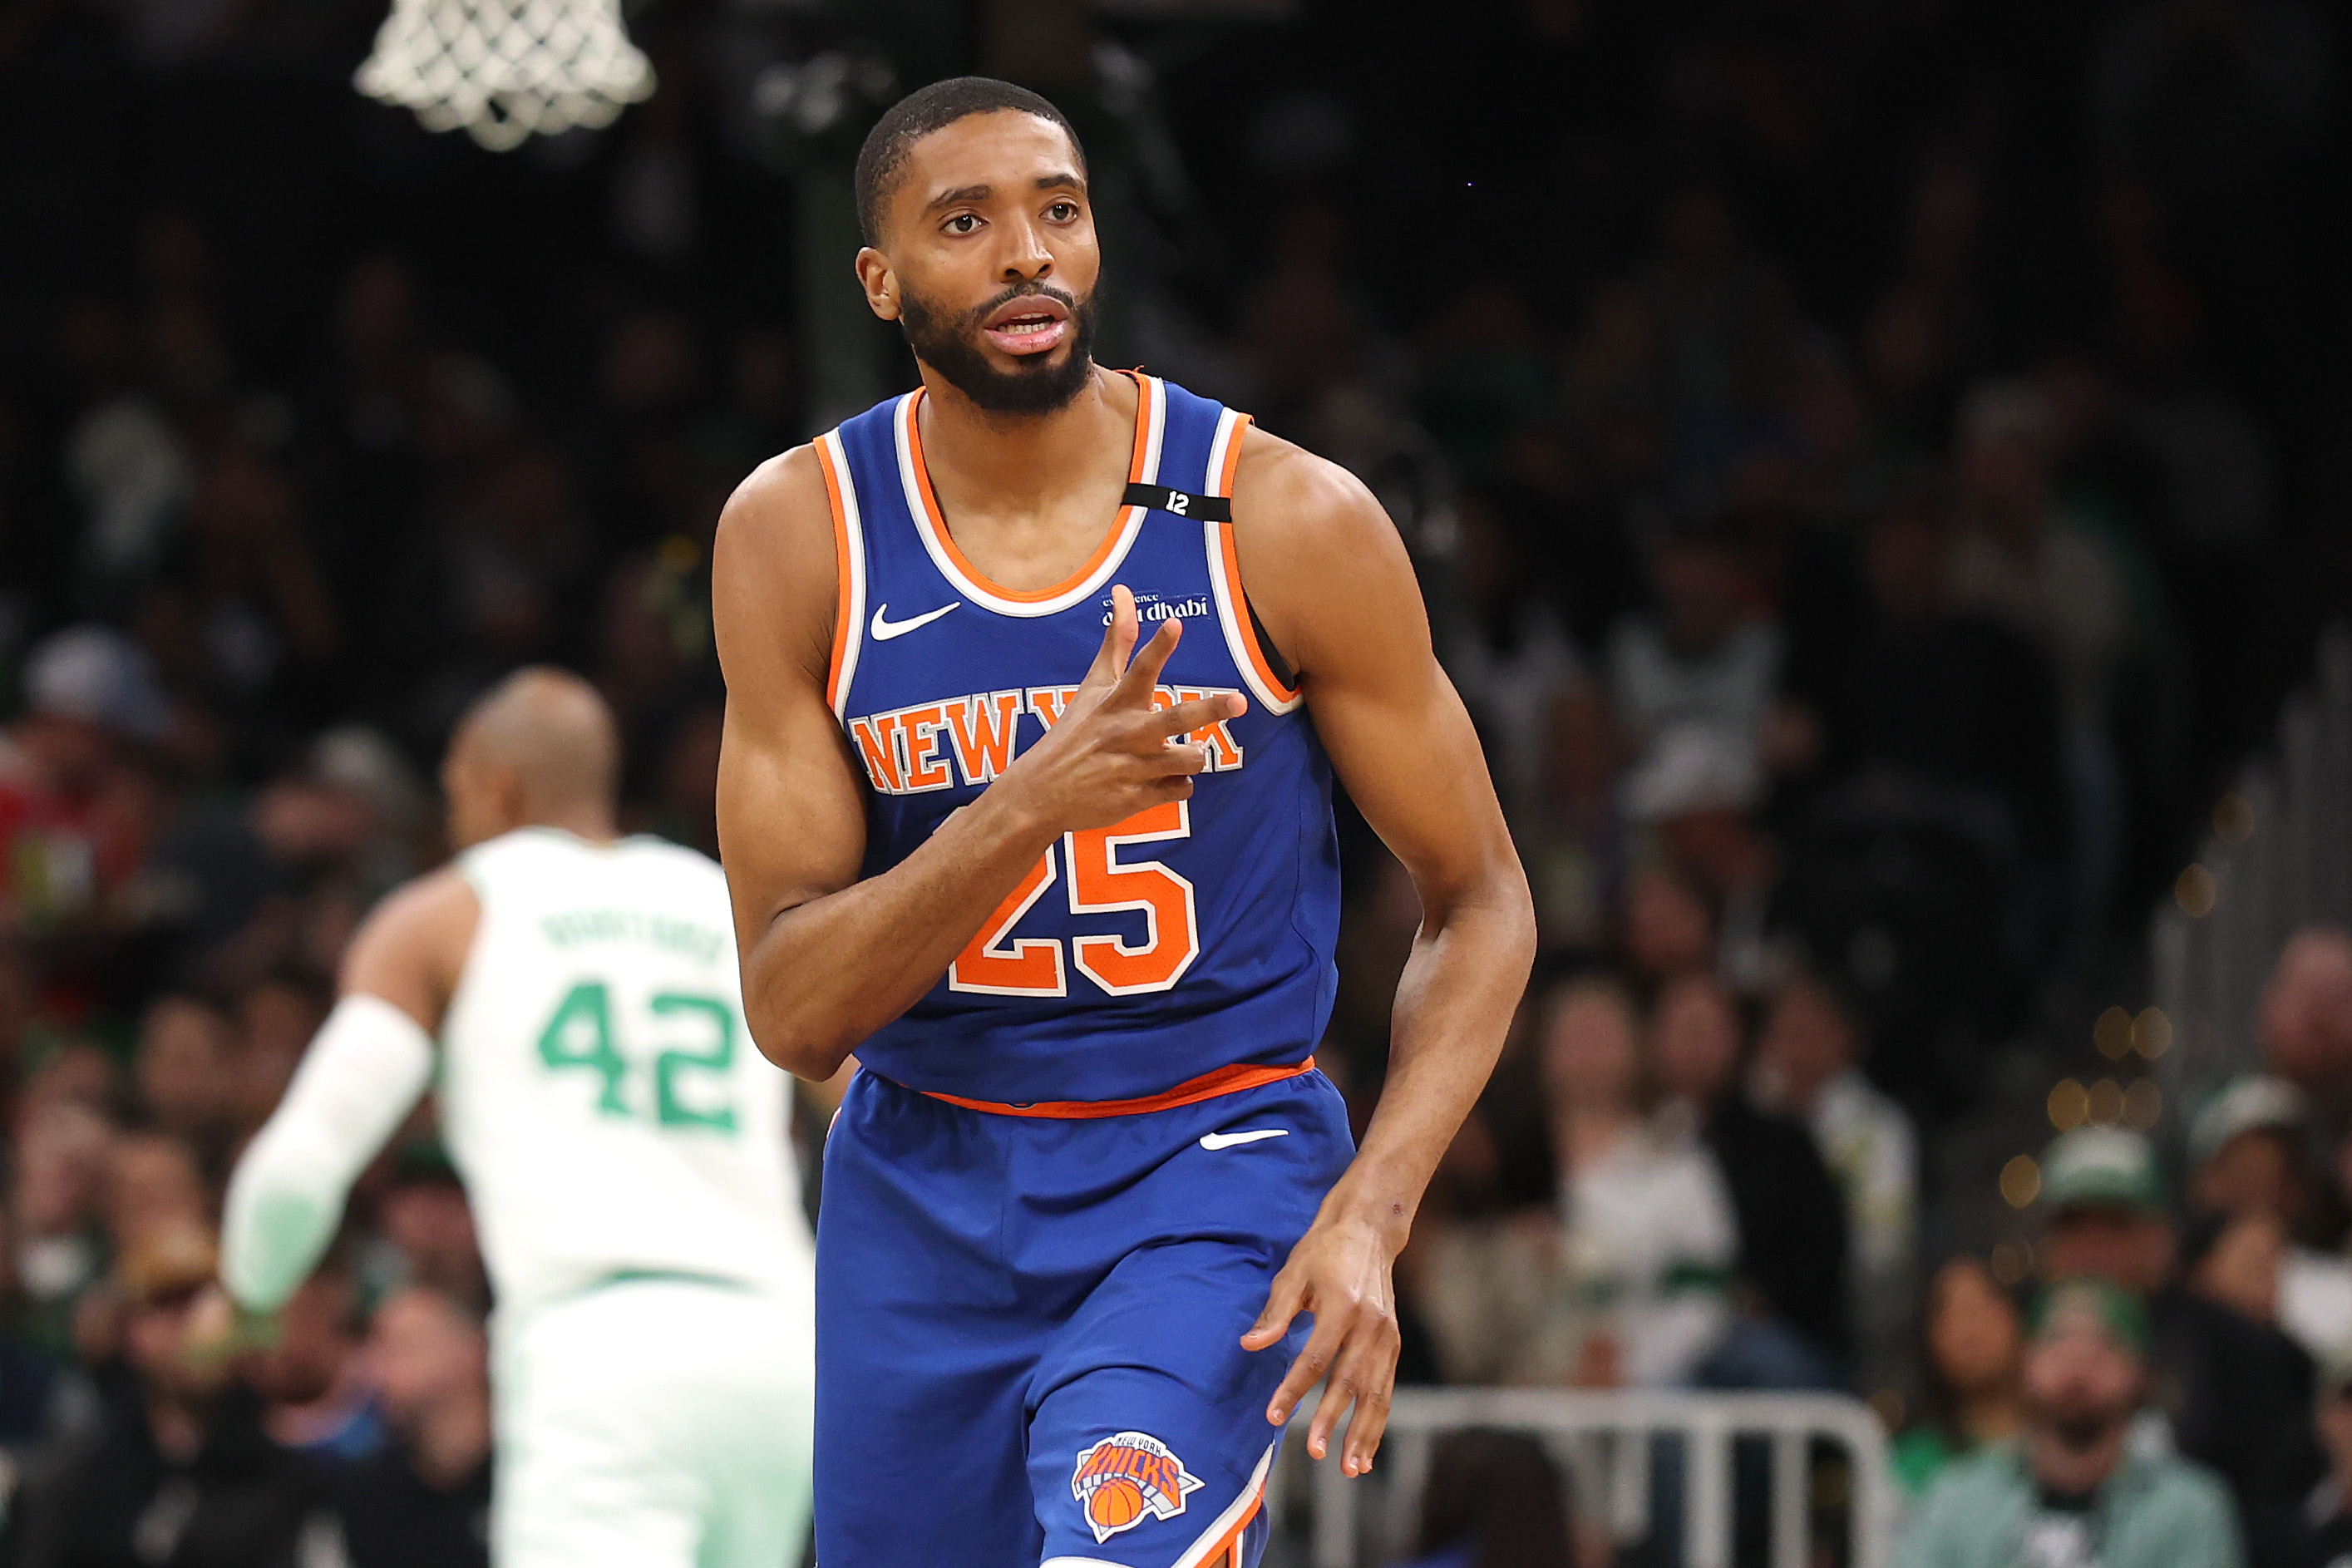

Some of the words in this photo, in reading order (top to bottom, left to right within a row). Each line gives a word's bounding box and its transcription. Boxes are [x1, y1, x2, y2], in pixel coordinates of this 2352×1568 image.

[1166, 491, 1189, 515] 12
[1146, 597, 1208, 621] dhabi
[848, 688, 1024, 796] NEW
[1026, 684, 1244, 773] YK
[933, 800, 1200, 997] 25
[538, 981, 737, 1128] 42
[1074, 1442, 1181, 1508] KNICKS
[1115, 1436, 1136, 1446] NEW
[1138, 1437, 1161, 1456] YORK
